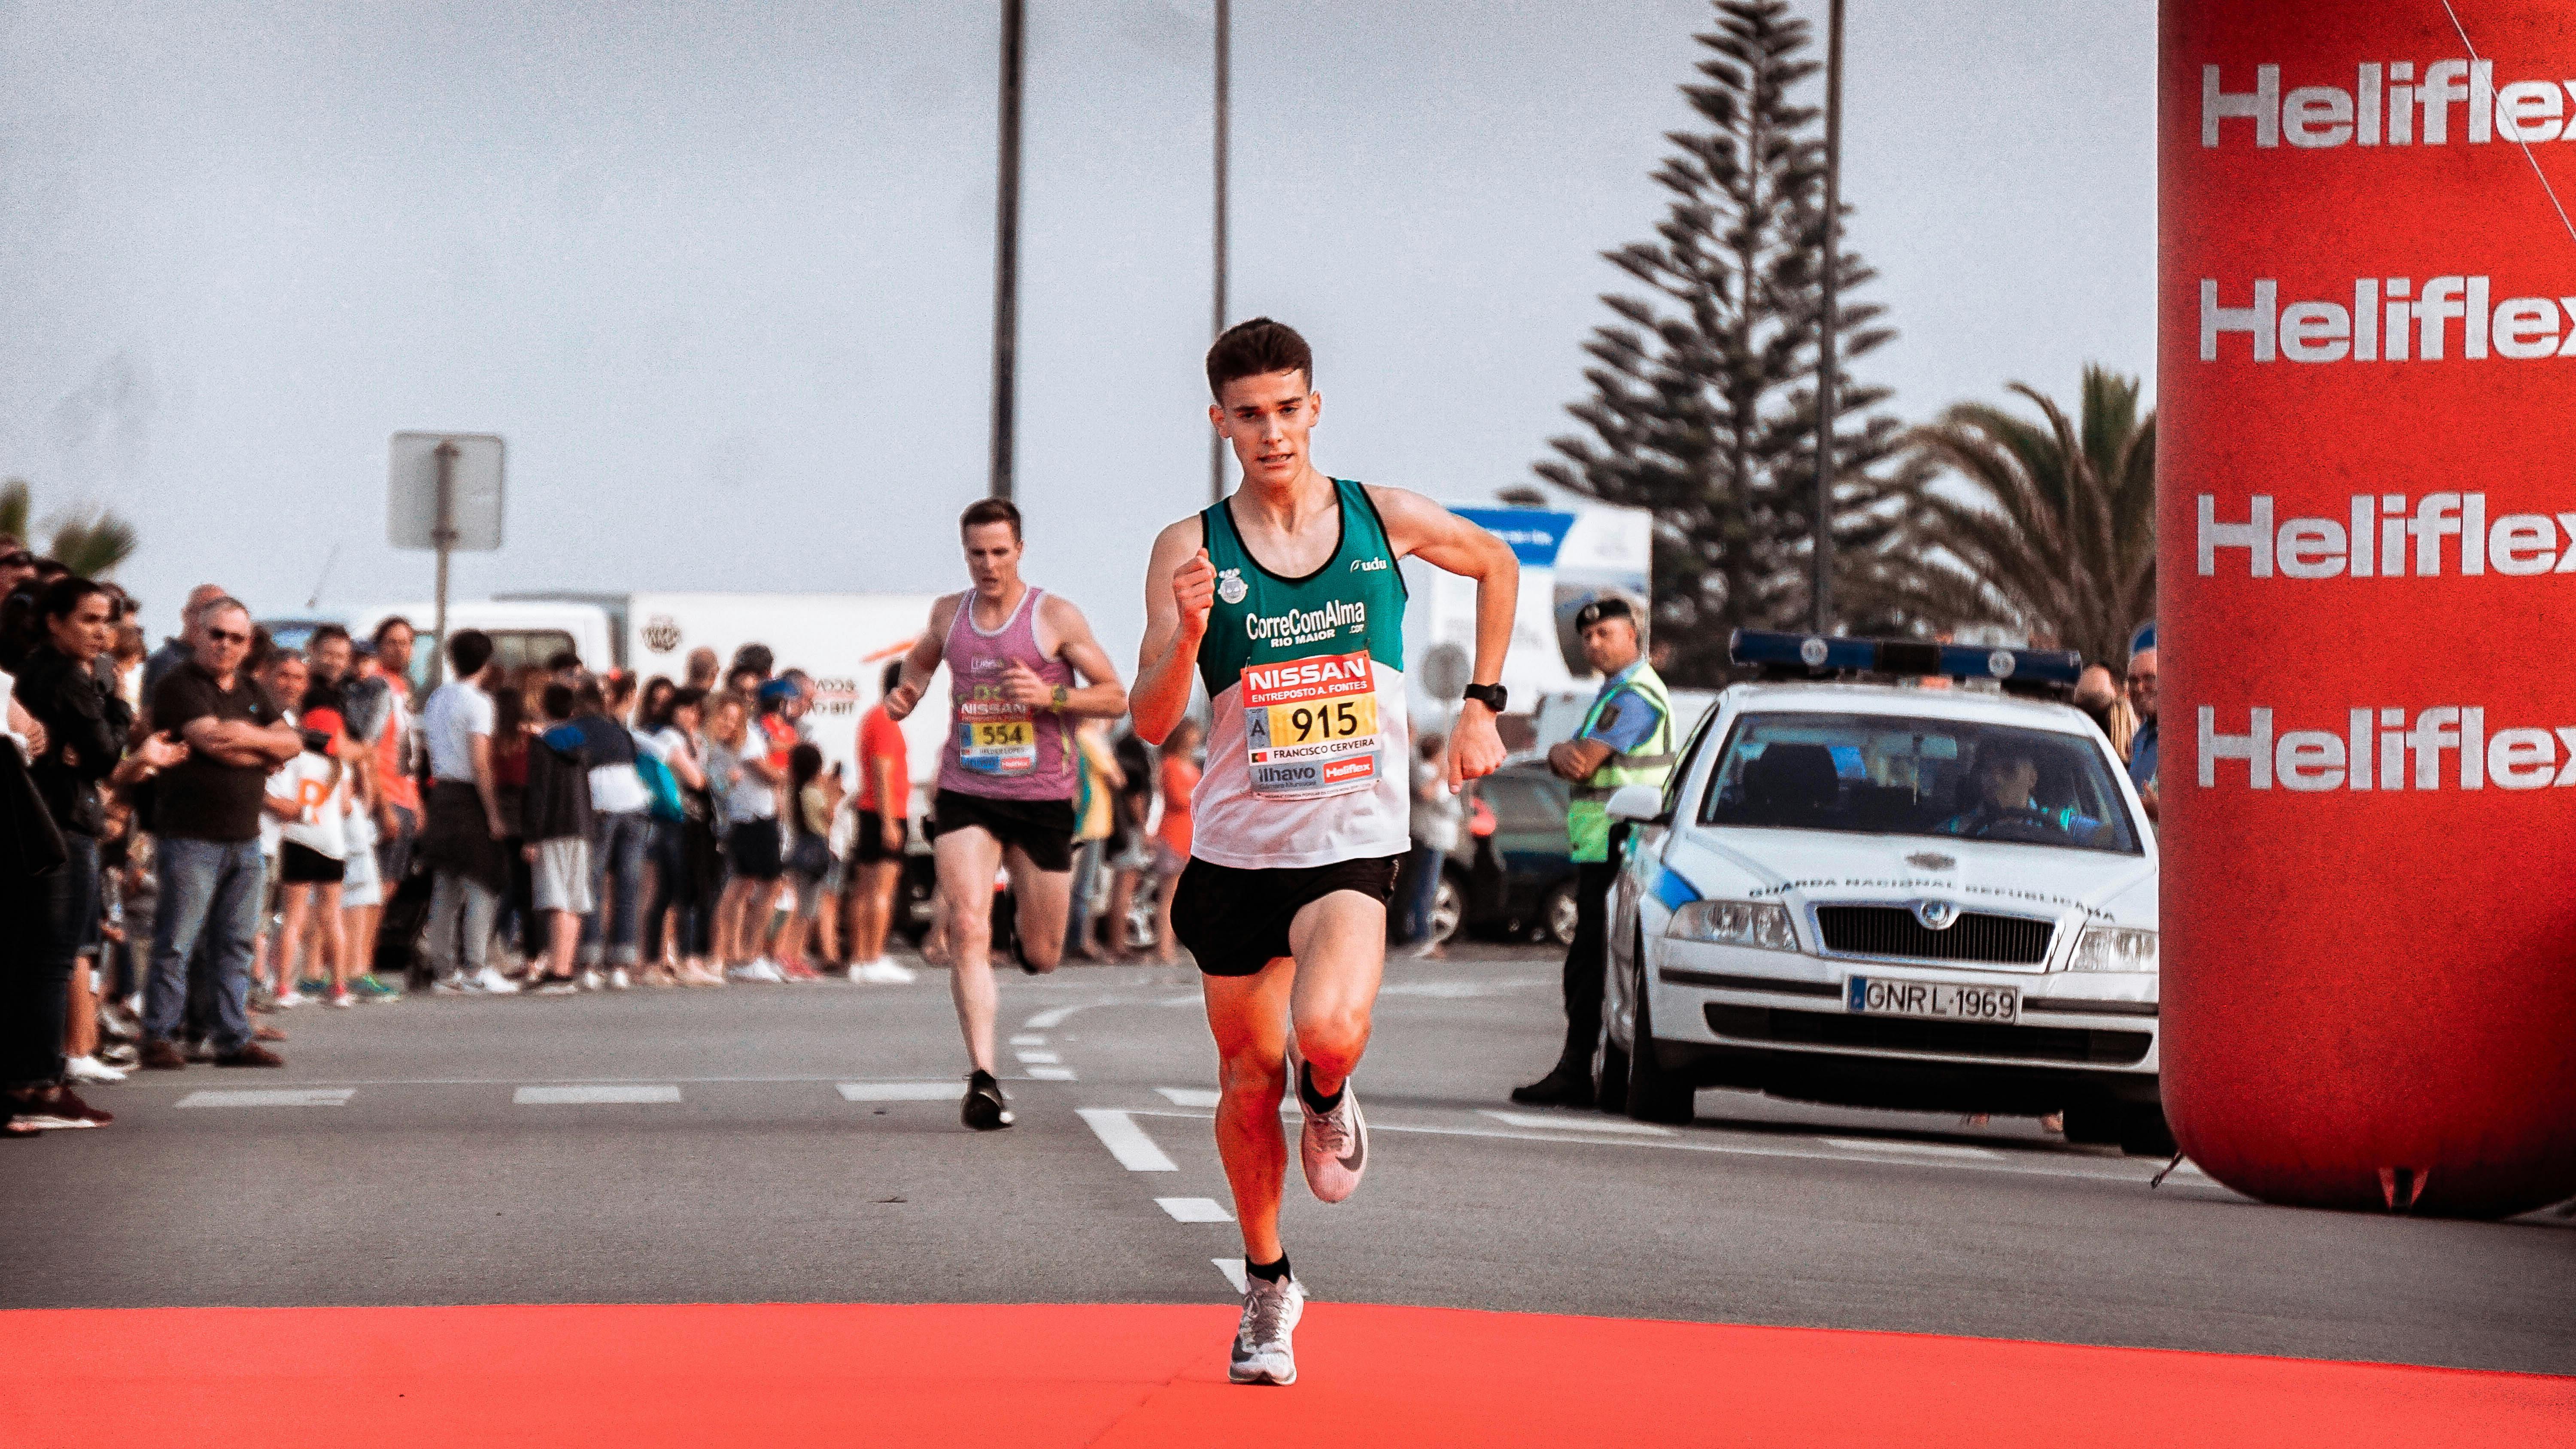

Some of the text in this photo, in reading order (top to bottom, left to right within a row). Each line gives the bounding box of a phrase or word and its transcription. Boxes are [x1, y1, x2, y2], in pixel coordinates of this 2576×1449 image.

[2202, 59, 2576, 149] Helifle
[2200, 276, 2576, 363] Helifle
[1361, 557, 1387, 571] udu
[1246, 600, 1365, 640] CorreComAlma
[1271, 629, 1336, 648] RIO MAIOR
[1249, 658, 1367, 691] NISSAN
[1252, 688, 1316, 703] ENTREPOSTO
[1329, 681, 1367, 693] FONTES
[961, 703, 1027, 714] NISSAN
[1250, 719, 1265, 737] A
[1292, 702, 1358, 742] 915
[983, 724, 1022, 745] 554
[1274, 738, 1374, 758] FRANCISCO CERVEIRA
[1326, 763, 1371, 778] Heliflex
[1749, 878, 2115, 922] GUARDA NACIONAL REPUBLICANA
